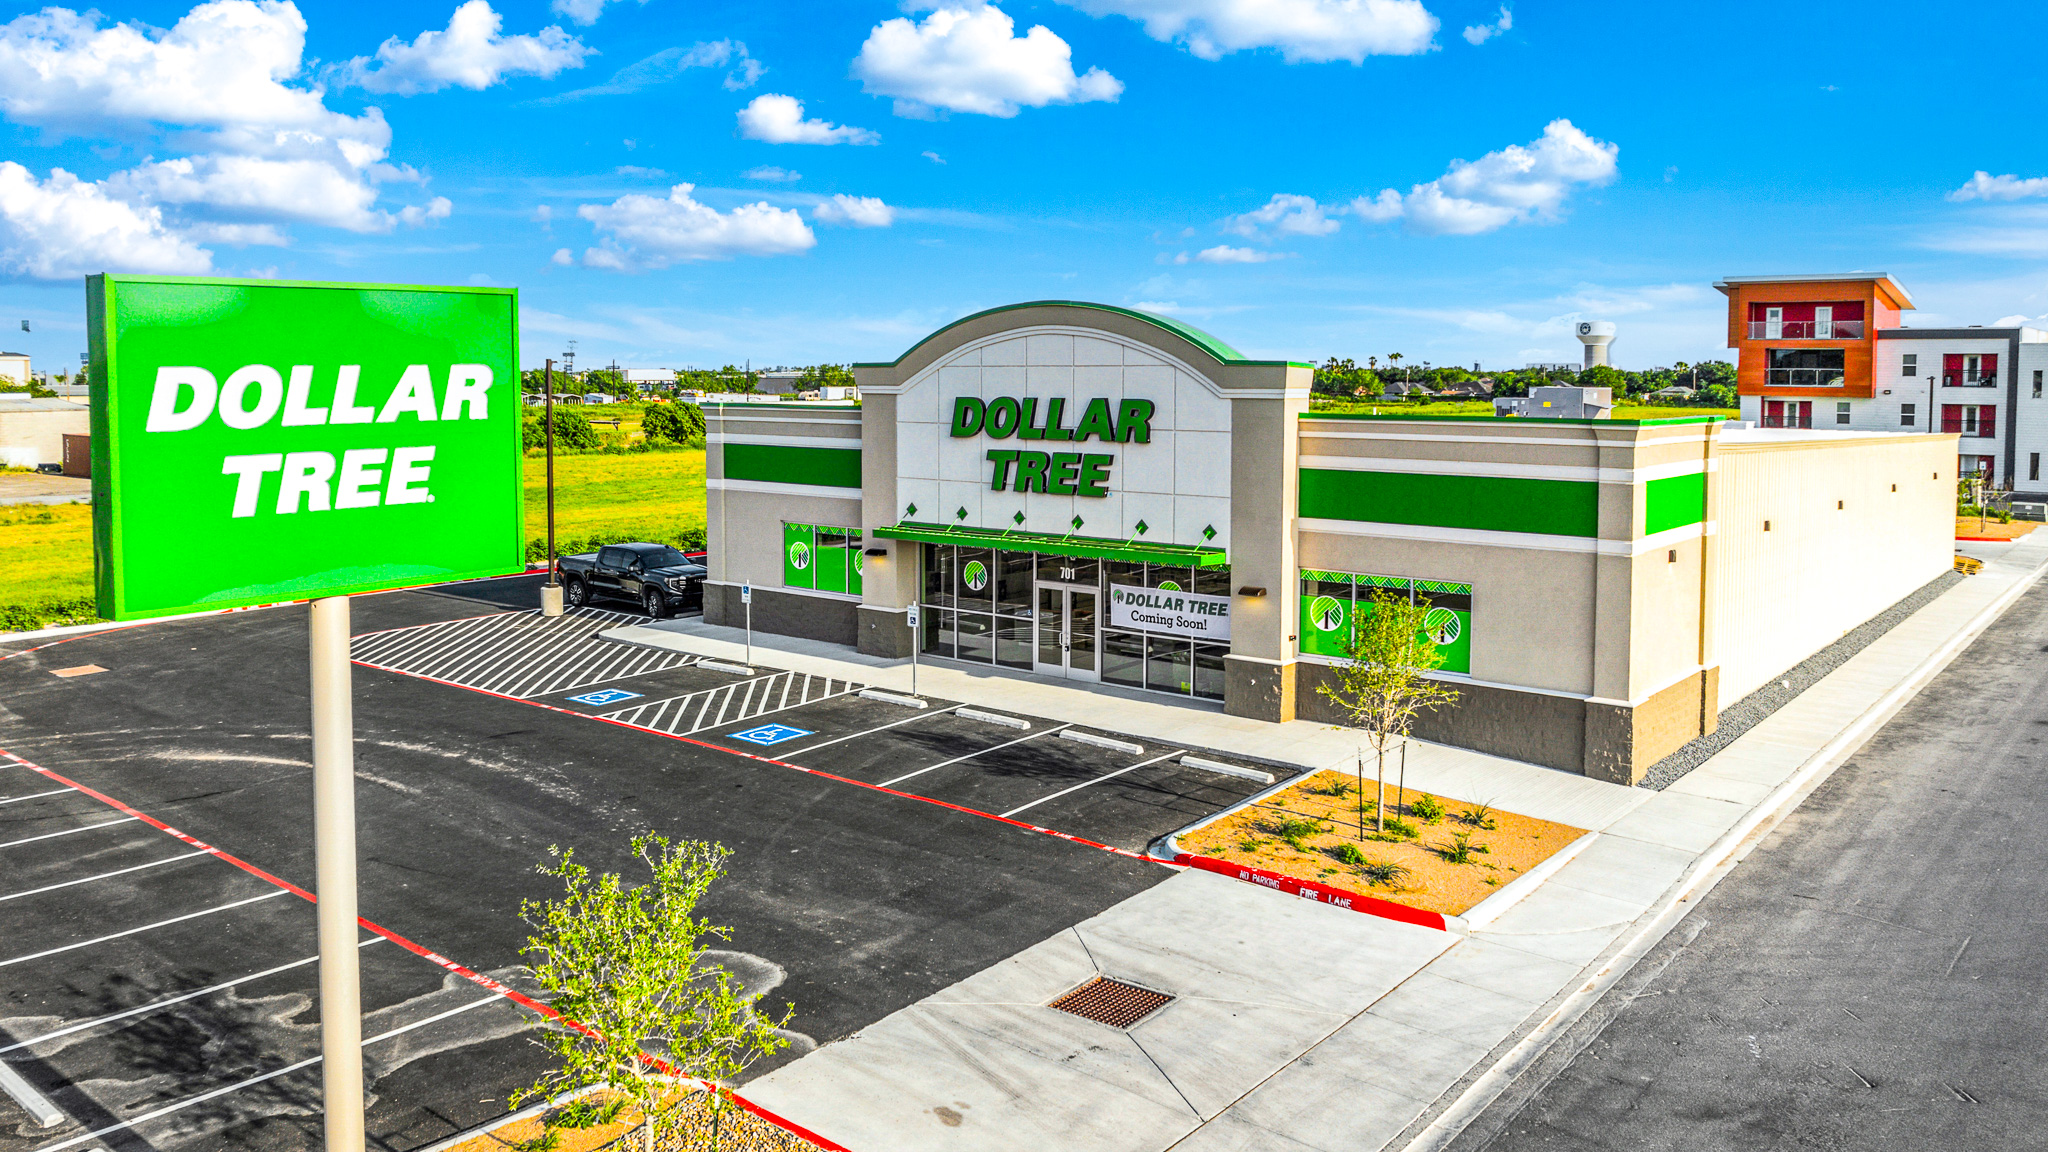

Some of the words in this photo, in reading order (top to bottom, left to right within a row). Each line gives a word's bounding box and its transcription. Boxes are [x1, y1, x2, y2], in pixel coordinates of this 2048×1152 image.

[146, 364, 494, 432] DOLLAR
[950, 396, 1155, 443] DOLLAR
[221, 445, 436, 518] TREE
[986, 449, 1114, 498] TREE
[1060, 567, 1075, 580] 701
[1125, 593, 1184, 611] DOLLAR
[1189, 600, 1228, 617] TREE
[1131, 610, 1173, 628] Coming
[1176, 616, 1207, 630] Soon!
[1240, 870, 1249, 880] NO
[1252, 874, 1280, 889] PARKING
[1300, 887, 1319, 900] FIRE
[1328, 894, 1352, 909] LANE
